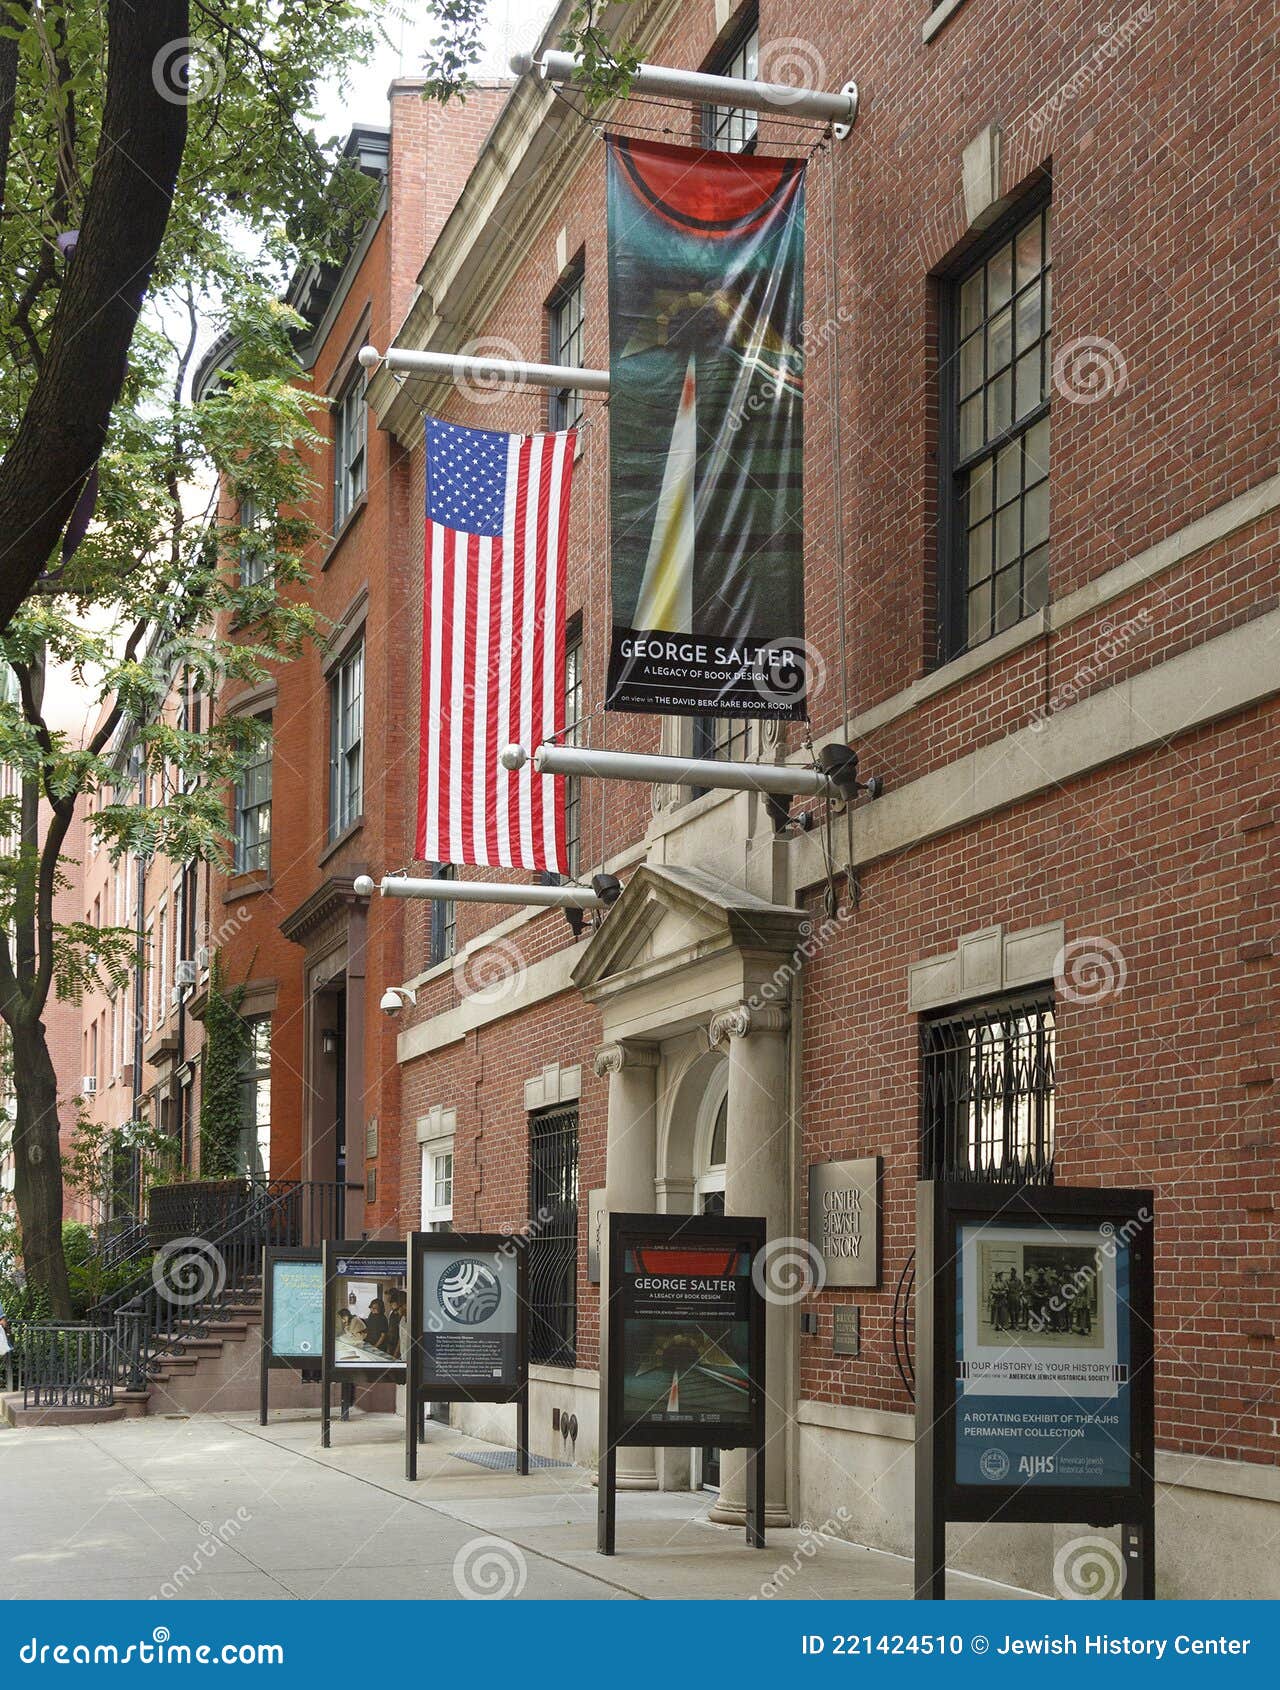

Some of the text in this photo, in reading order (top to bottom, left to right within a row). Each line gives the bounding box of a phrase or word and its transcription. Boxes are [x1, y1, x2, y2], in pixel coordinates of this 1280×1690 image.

[620, 639, 796, 668] GEORGE SALTER
[652, 667, 688, 678] LEGACY
[690, 669, 702, 678] OF
[704, 671, 732, 680] BOOK
[734, 672, 769, 681] DESIGN
[655, 696, 670, 705] THE
[672, 698, 696, 706] DAVID
[697, 699, 718, 707] BERG
[720, 700, 741, 708] RARE
[742, 701, 766, 709] BOOK
[767, 702, 792, 710] ROOM
[823, 1189, 862, 1212] CENTER
[827, 1210, 860, 1236] JEWISH
[822, 1235, 862, 1258] HISTORY
[634, 1278, 736, 1291] GEORGE SALTER
[971, 1362, 1111, 1372] OUR HISTORY IS YOUR HISTORY
[964, 1414, 1119, 1424] A ROTATING EXHIBIT OF THE AJHS
[964, 1427, 1084, 1438] PERMANENT COLLECTION
[1018, 1456, 1054, 1478] AJHS
